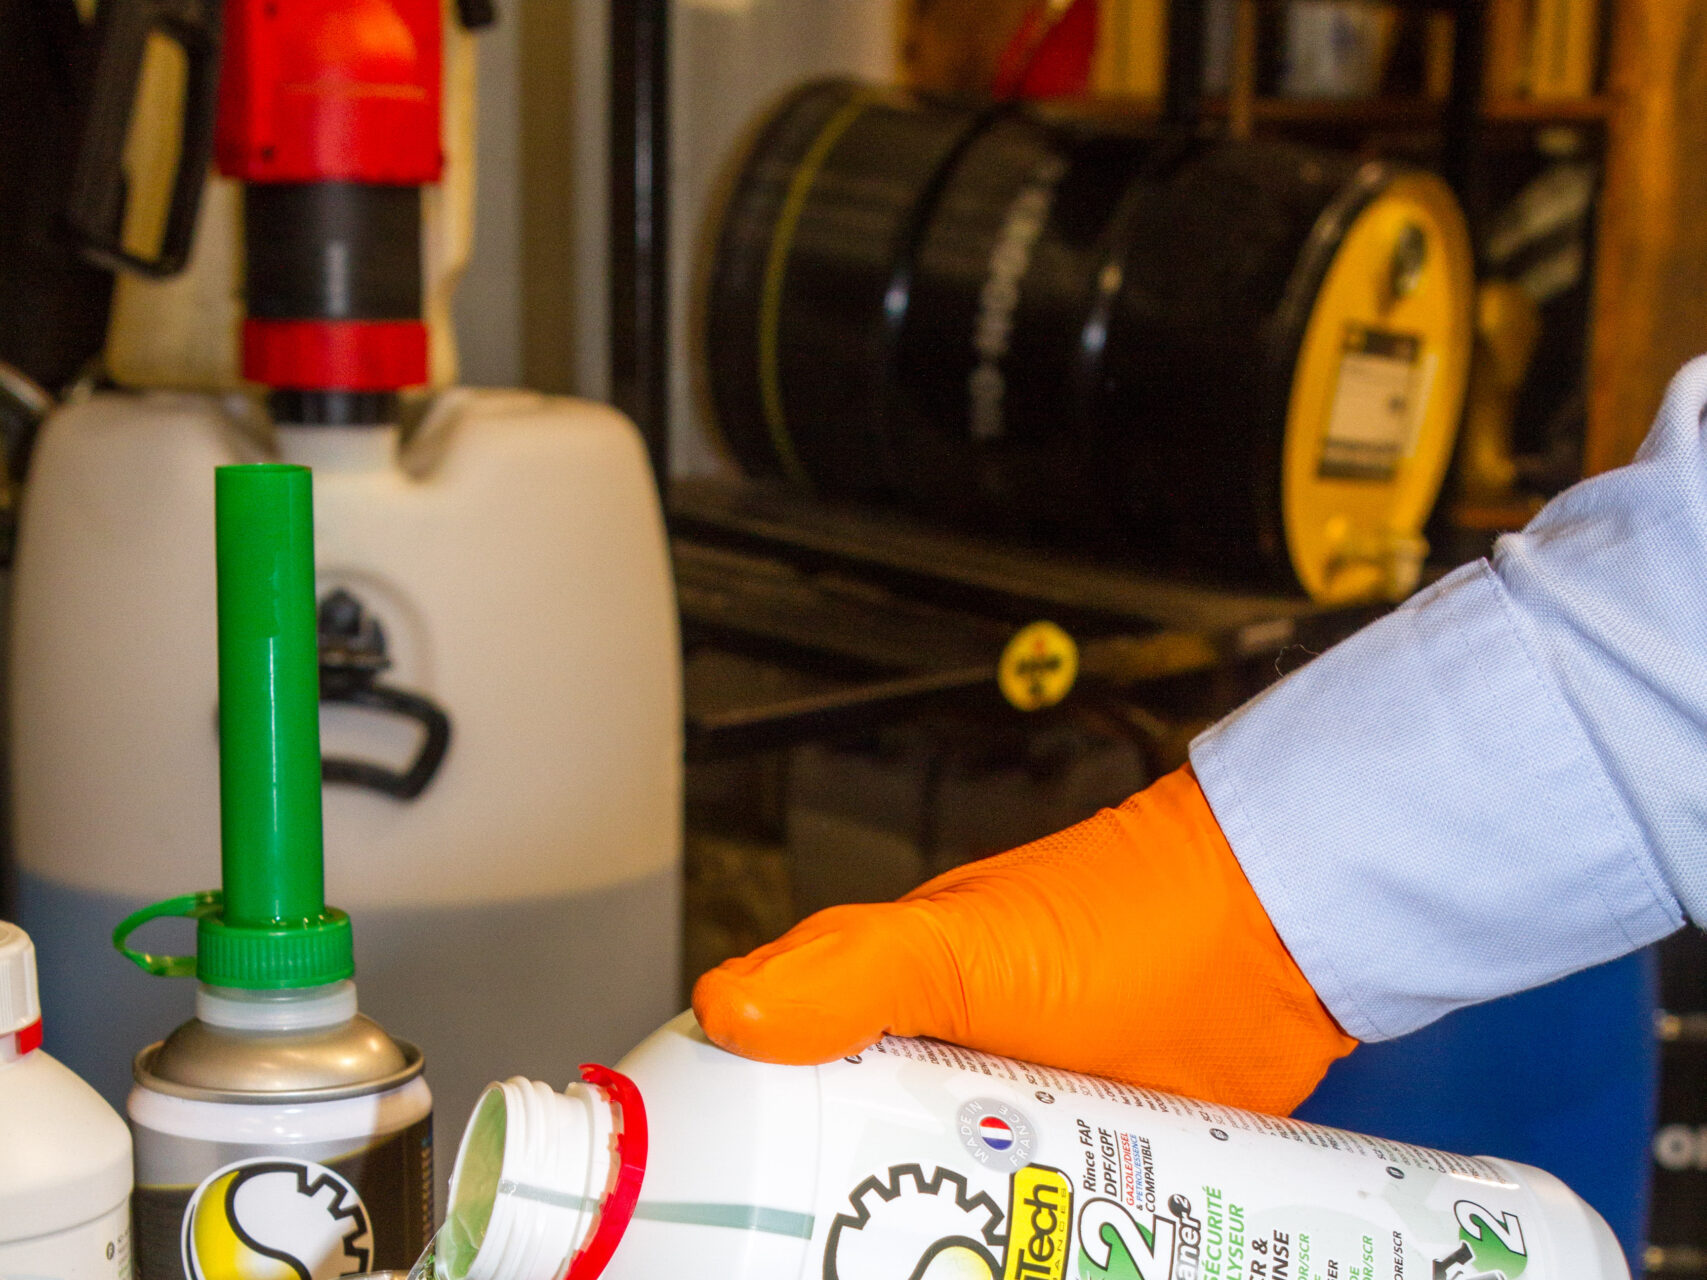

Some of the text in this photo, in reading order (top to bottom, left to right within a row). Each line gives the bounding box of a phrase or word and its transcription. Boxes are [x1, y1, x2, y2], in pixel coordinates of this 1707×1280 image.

[959, 1101, 1032, 1167] MADE IN FRANCE
[1077, 1118, 1096, 1193] Rince FAP
[1098, 1127, 1117, 1197] DPF/GPF
[1130, 1134, 1143, 1202] PETROL/ESSENCE
[1120, 1132, 1135, 1206] GAZOLE/DIESEL
[1139, 1136, 1156, 1213] COMPATIBLE
[1252, 1238, 1268, 1255] &
[1454, 1200, 1528, 1257] 2
